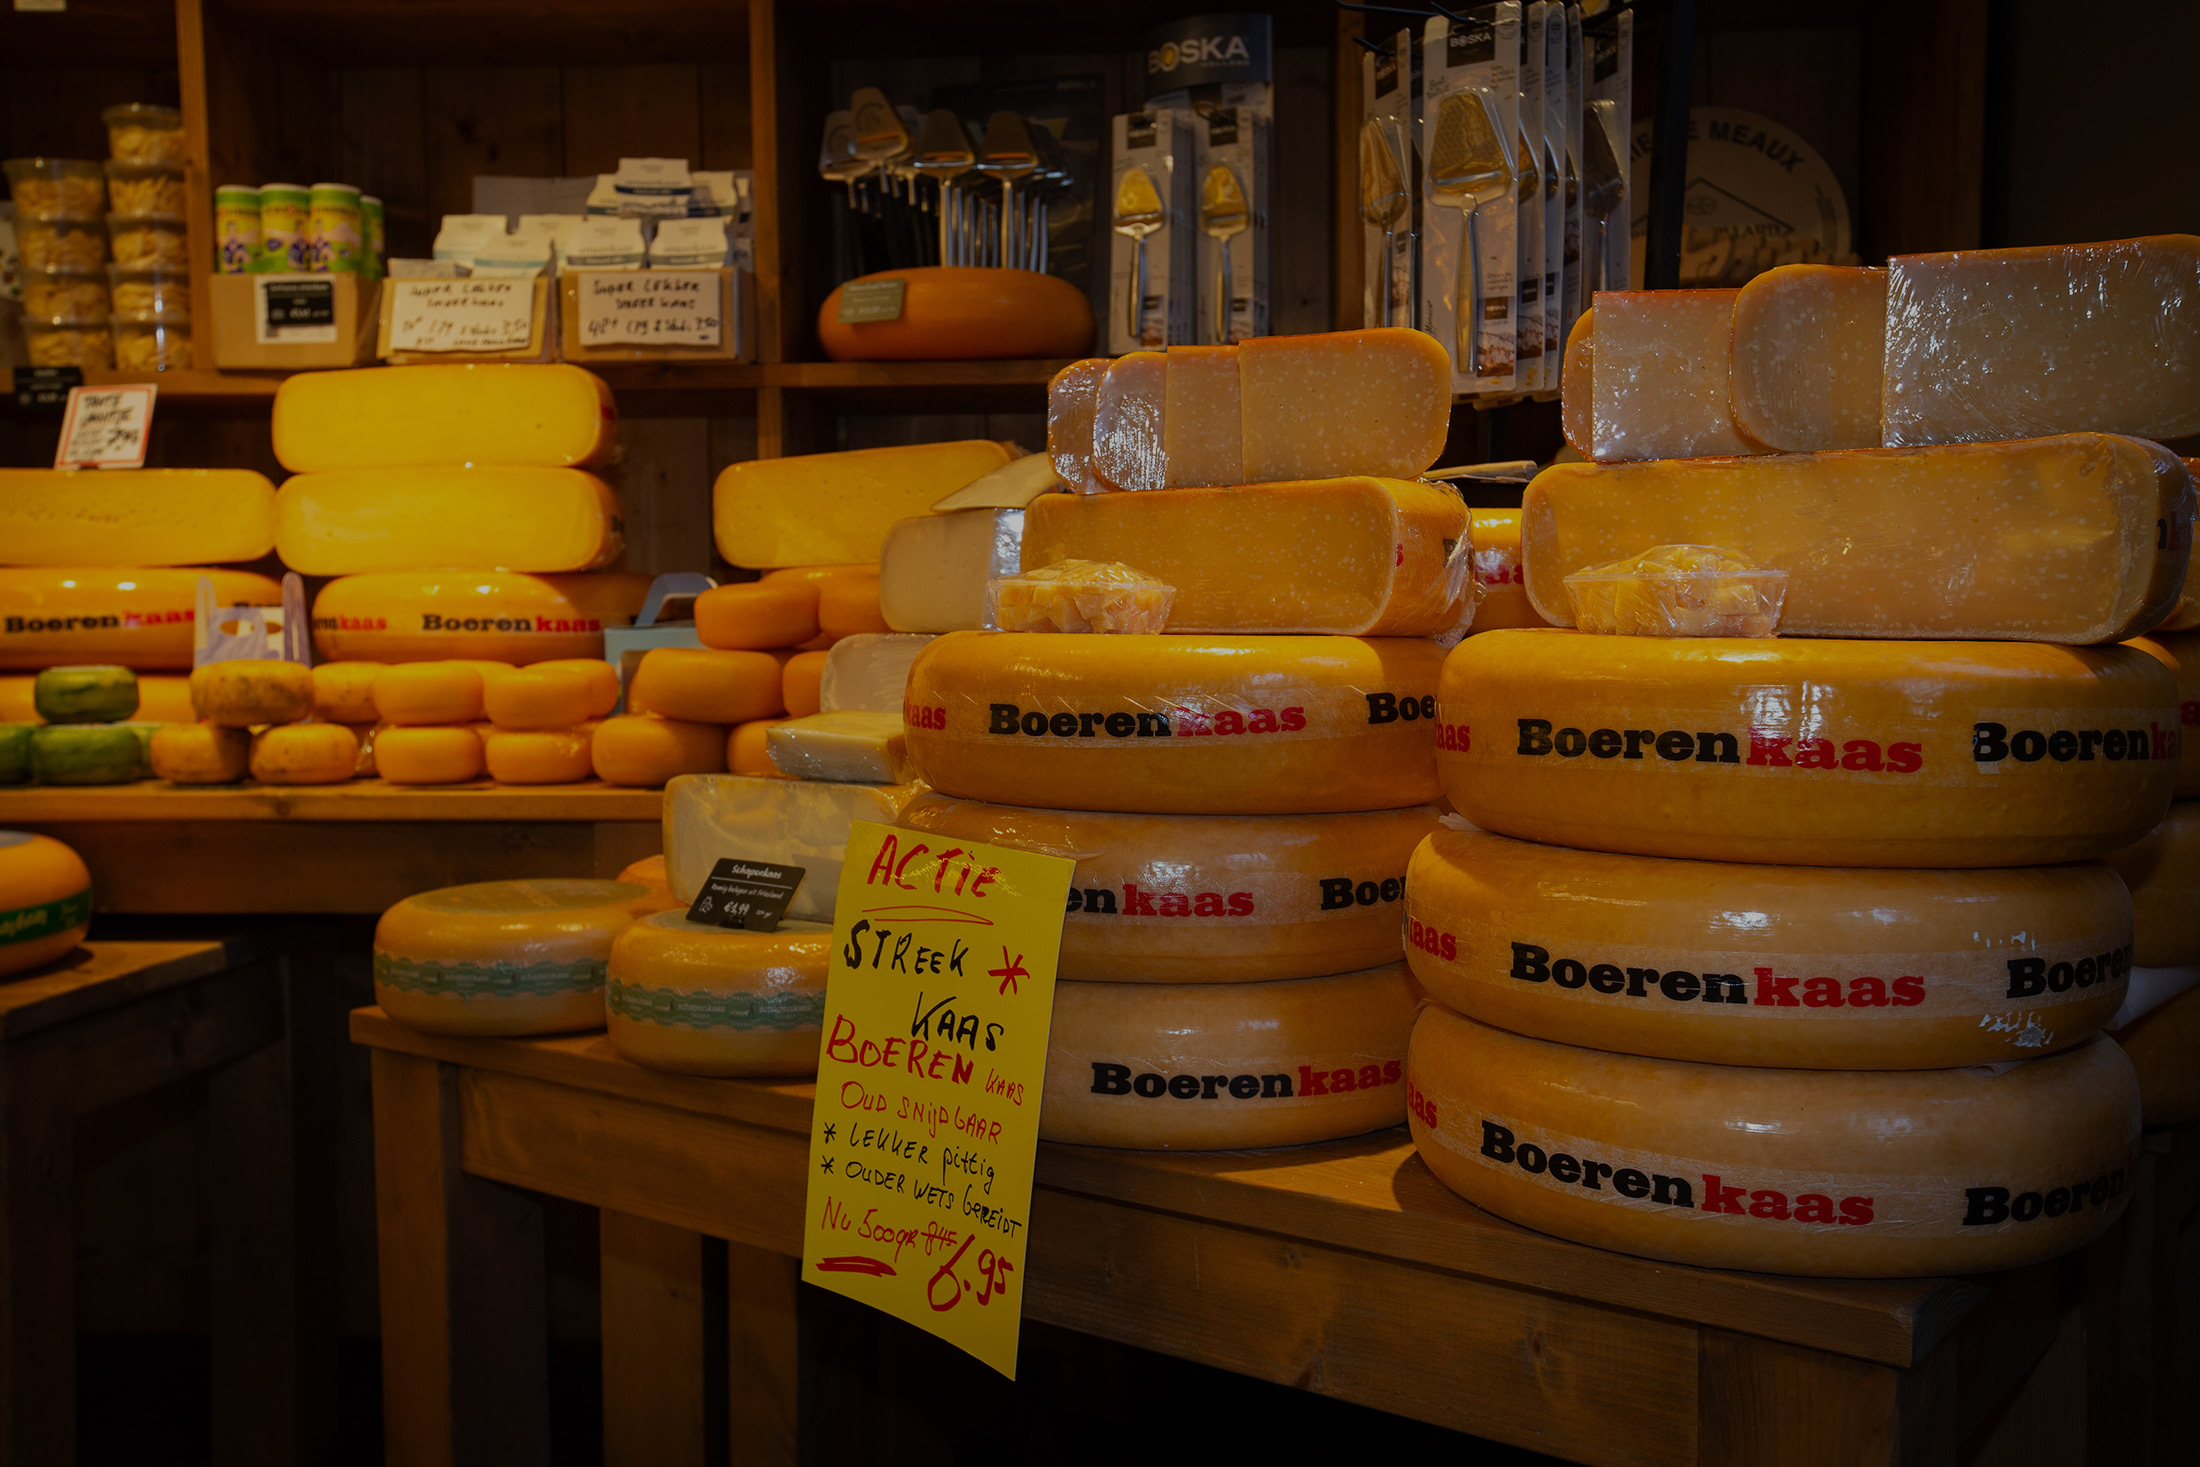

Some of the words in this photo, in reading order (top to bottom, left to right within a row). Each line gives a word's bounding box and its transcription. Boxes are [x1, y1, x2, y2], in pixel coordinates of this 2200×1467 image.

[1147, 35, 1250, 75] BOSKA
[1450, 32, 1492, 48] BOSKA
[1707, 120, 1804, 174] MEAUX
[731, 864, 783, 880] Schapenkaas
[866, 834, 1001, 898] ACTiE
[844, 919, 969, 977] STREEK
[911, 992, 1004, 1051] KAAS
[826, 1014, 974, 1084] BOEREN
[985, 1068, 1024, 1106] KAAS
[841, 1081, 887, 1112] OUD
[850, 1122, 928, 1165] LEKKER
[943, 1147, 995, 1195] pittig
[821, 1197, 851, 1231] Nu
[927, 1234, 1015, 1312] 6.95
